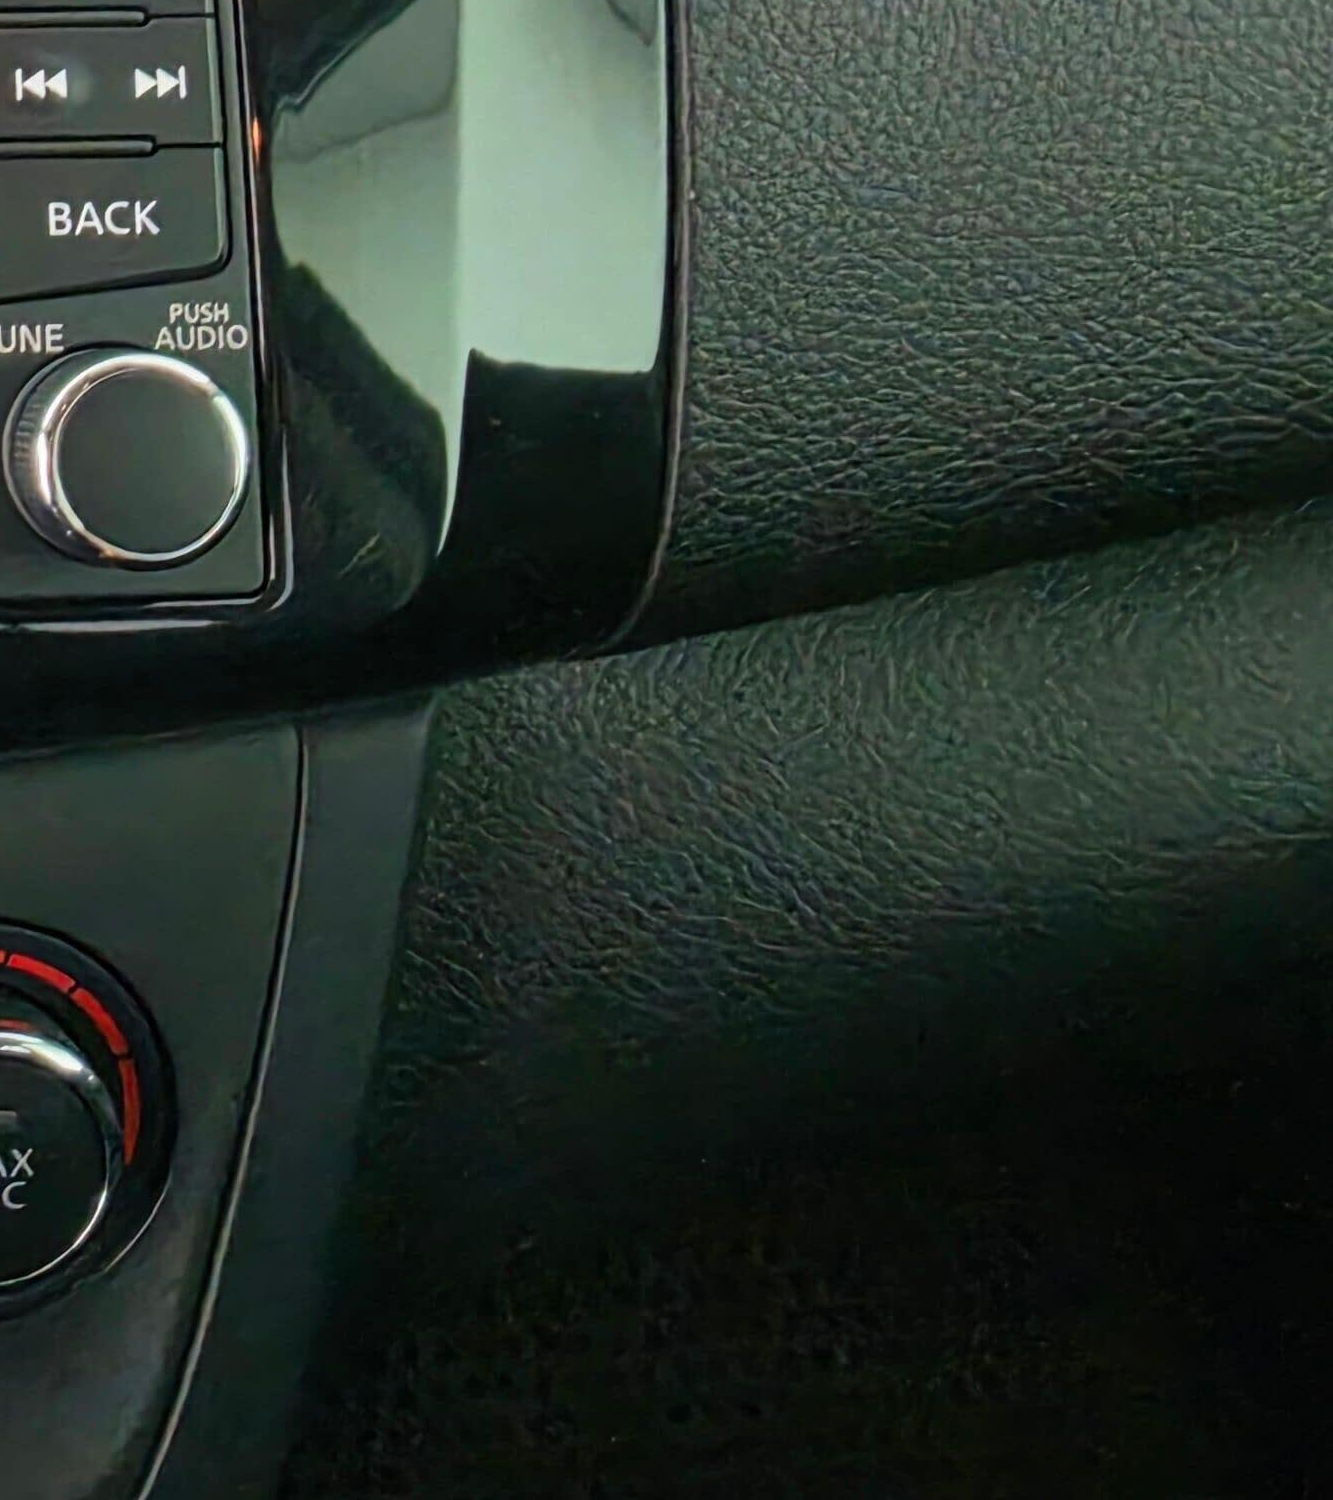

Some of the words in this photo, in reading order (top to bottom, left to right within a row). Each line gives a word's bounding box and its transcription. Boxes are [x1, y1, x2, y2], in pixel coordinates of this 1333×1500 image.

[47, 199, 161, 237] BACK
[169, 302, 230, 324] PUSH
[154, 323, 248, 351] AUDIO
